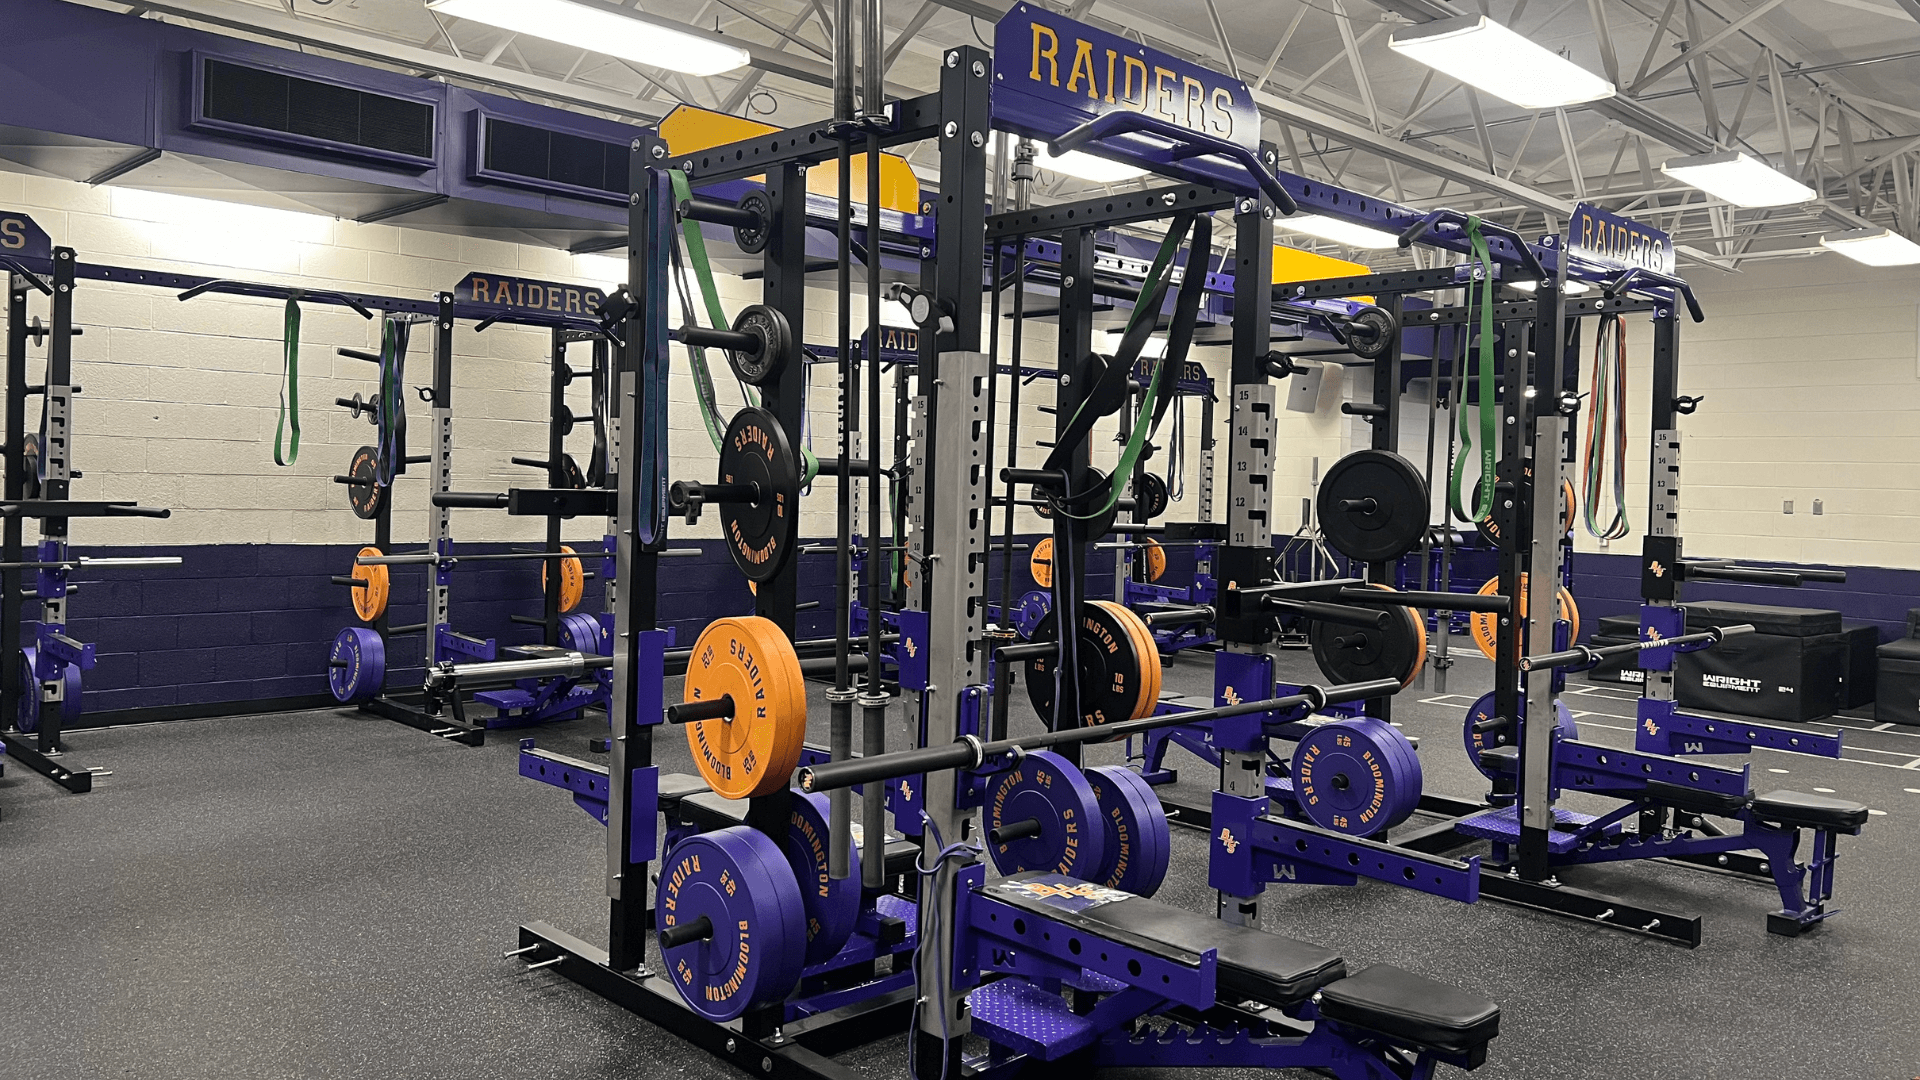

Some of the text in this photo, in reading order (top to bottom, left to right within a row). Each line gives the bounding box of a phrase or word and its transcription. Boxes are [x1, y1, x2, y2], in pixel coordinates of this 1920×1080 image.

[1029, 22, 1234, 139] RAIDERS
[1581, 213, 1664, 273] RAIDERS
[471, 277, 600, 316] RAIDERS
[1239, 390, 1249, 400] 15
[917, 401, 924, 409] 15
[1238, 426, 1248, 436] 14
[1658, 433, 1667, 441] 15
[734, 425, 774, 462] RAIDERS
[1237, 461, 1247, 471] 13
[1483, 449, 1492, 501] WRIGHT
[915, 486, 922, 494] 12
[1235, 497, 1245, 507] 12
[914, 515, 921, 523] 11
[730, 519, 777, 565] BLOOMINGTON
[1235, 533, 1245, 543] 11
[913, 542, 920, 551] 10
[914, 571, 919, 579] 9
[1083, 616, 1119, 654] INGTON
[701, 653, 711, 669] 25
[1034, 662, 1045, 672] LBS
[730, 638, 767, 719] RAIDERS
[1114, 672, 1124, 685] 10
[1620, 669, 1644, 678] WRI
[1702, 673, 1762, 688] WRIGHT
[1112, 684, 1124, 694] LBS
[1702, 681, 1761, 693] EQUIPMENT
[1778, 685, 1794, 694] 24
[693, 687, 732, 781] BLOOMINGN
[1343, 735, 1352, 748] 45
[1036, 769, 1046, 785] 45
[1301, 744, 1321, 805] RAIDERS
[1359, 750, 1385, 824] BLOOMINGTON
[993, 770, 1023, 854] BOMINGTON
[1339, 816, 1348, 829] 45
[791, 811, 829, 898] OOMINGTON
[1107, 807, 1130, 889] BLOOMINGTO
[665, 854, 702, 926] RAIDERS
[726, 878, 736, 897] 45
[705, 920, 750, 1002] BLOOMINGTON
[682, 967, 693, 985] 45
